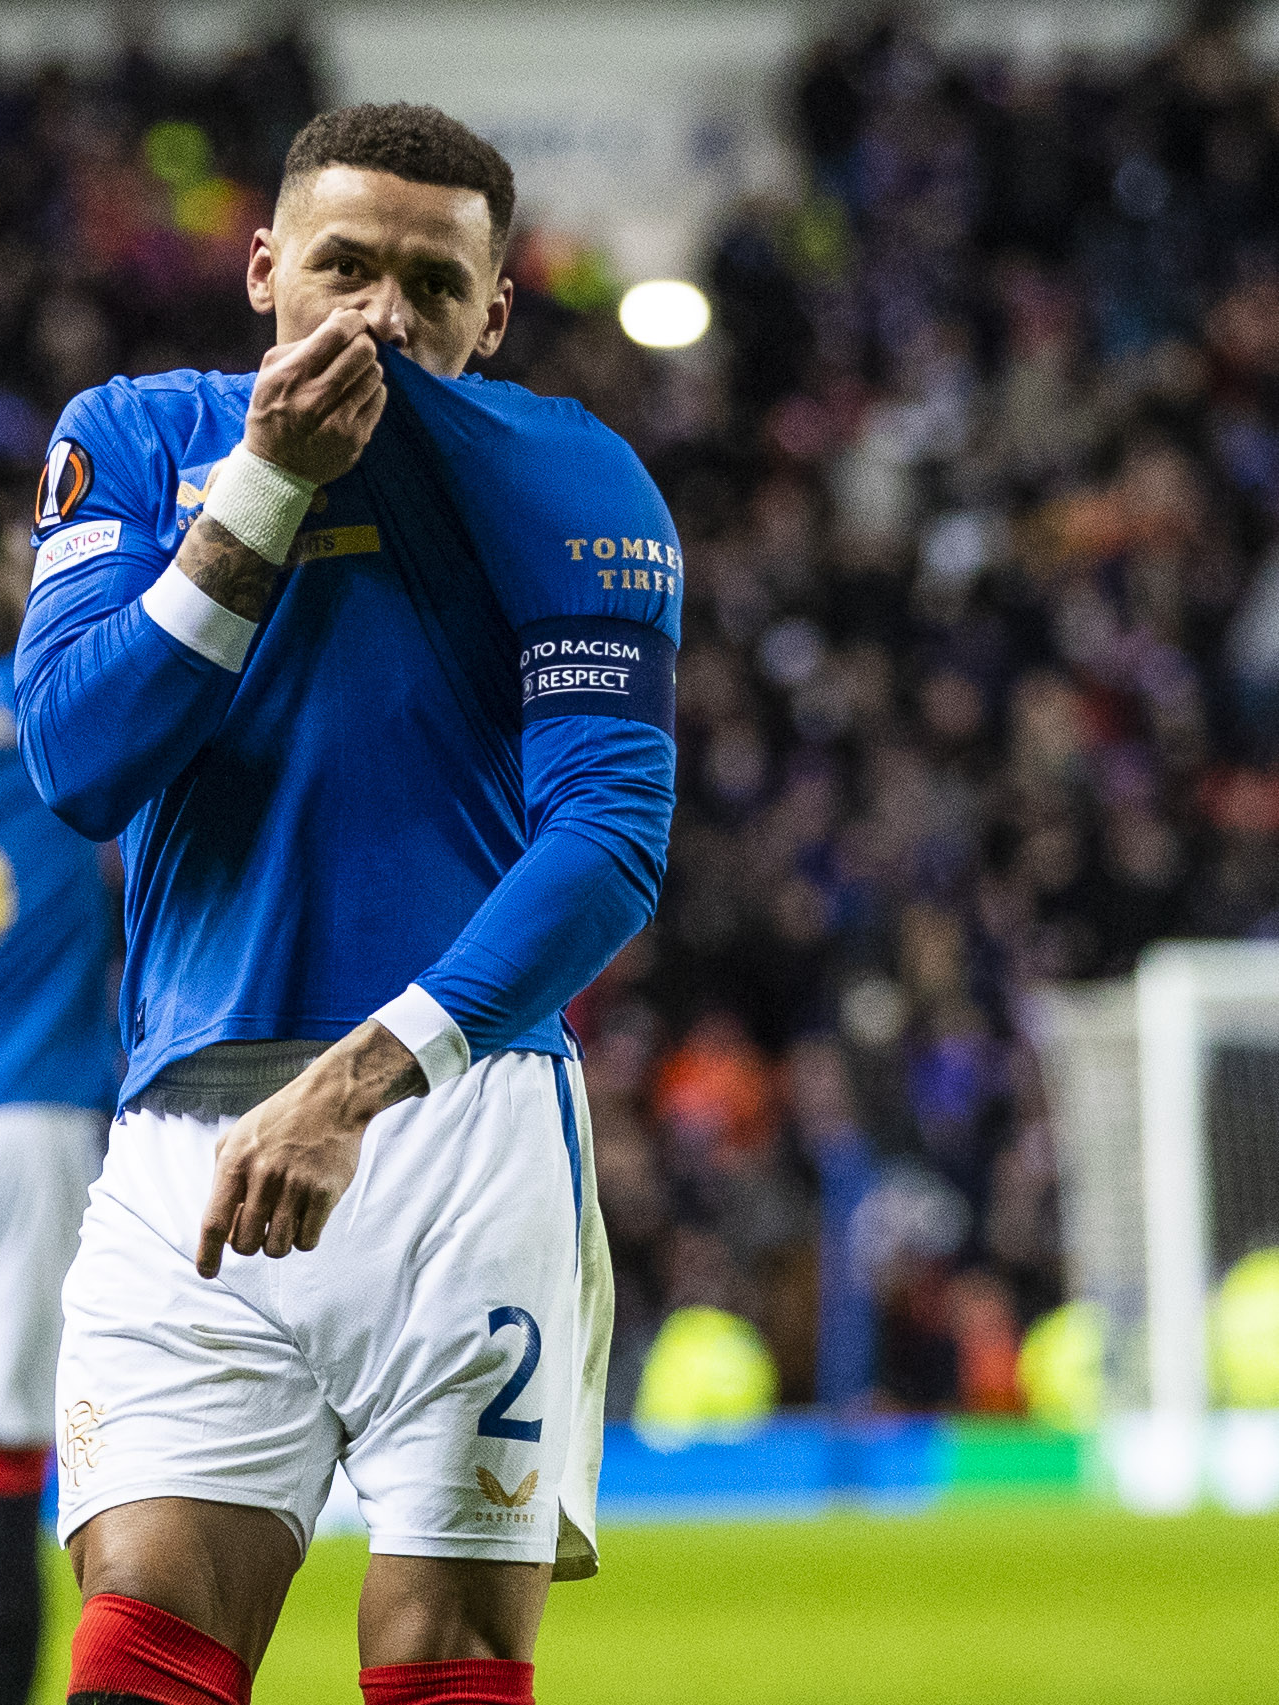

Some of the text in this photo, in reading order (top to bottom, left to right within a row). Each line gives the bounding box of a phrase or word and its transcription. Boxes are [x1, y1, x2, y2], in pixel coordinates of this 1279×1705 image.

[40, 530, 114, 567] NDATION
[597, 569, 675, 595] TIRES
[532, 642, 556, 660] TO
[561, 640, 640, 661] RACISM
[538, 669, 630, 690] RESPECT
[477, 1306, 544, 1443] 2
[475, 1511, 536, 1524] CASTORE
